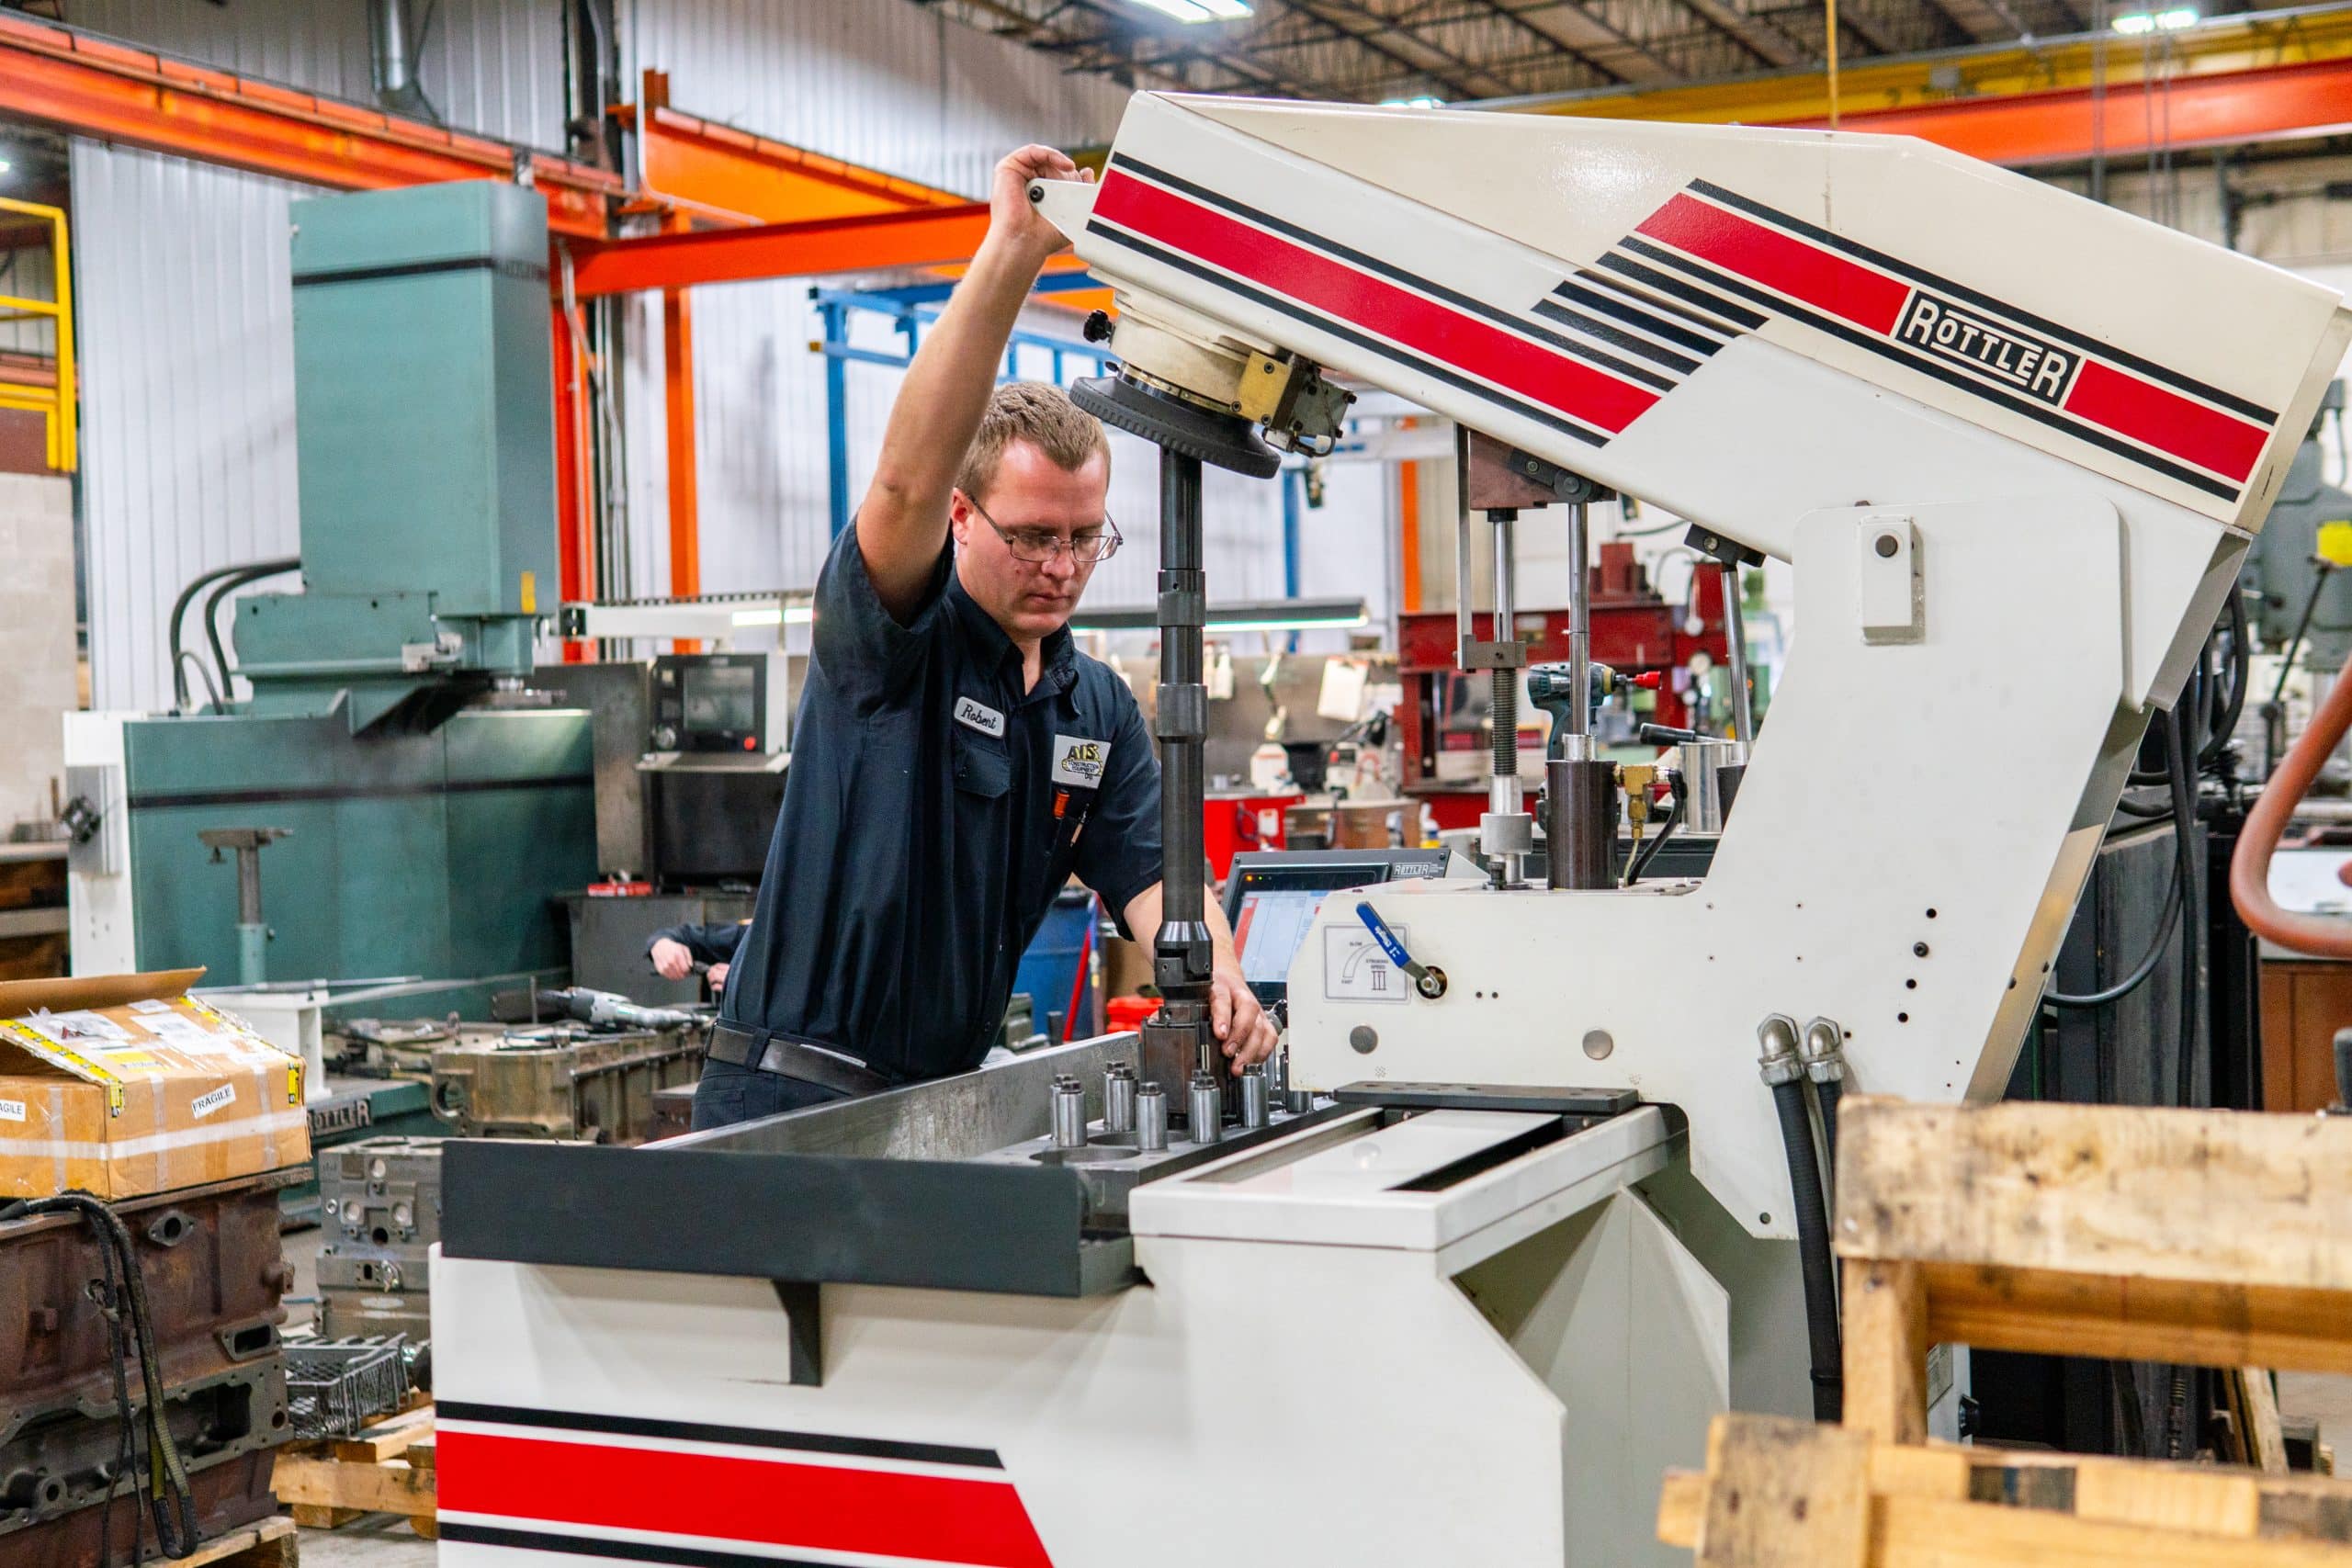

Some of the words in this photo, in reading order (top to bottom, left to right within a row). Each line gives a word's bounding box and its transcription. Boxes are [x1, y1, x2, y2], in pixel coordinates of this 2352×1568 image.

[1905, 299, 2068, 398] ROTTLER
[961, 704, 997, 729] Robert
[1067, 743, 1101, 761] AIS
[1394, 863, 1430, 875] ROTTLER
[192, 1087, 232, 1112] FRAGILE
